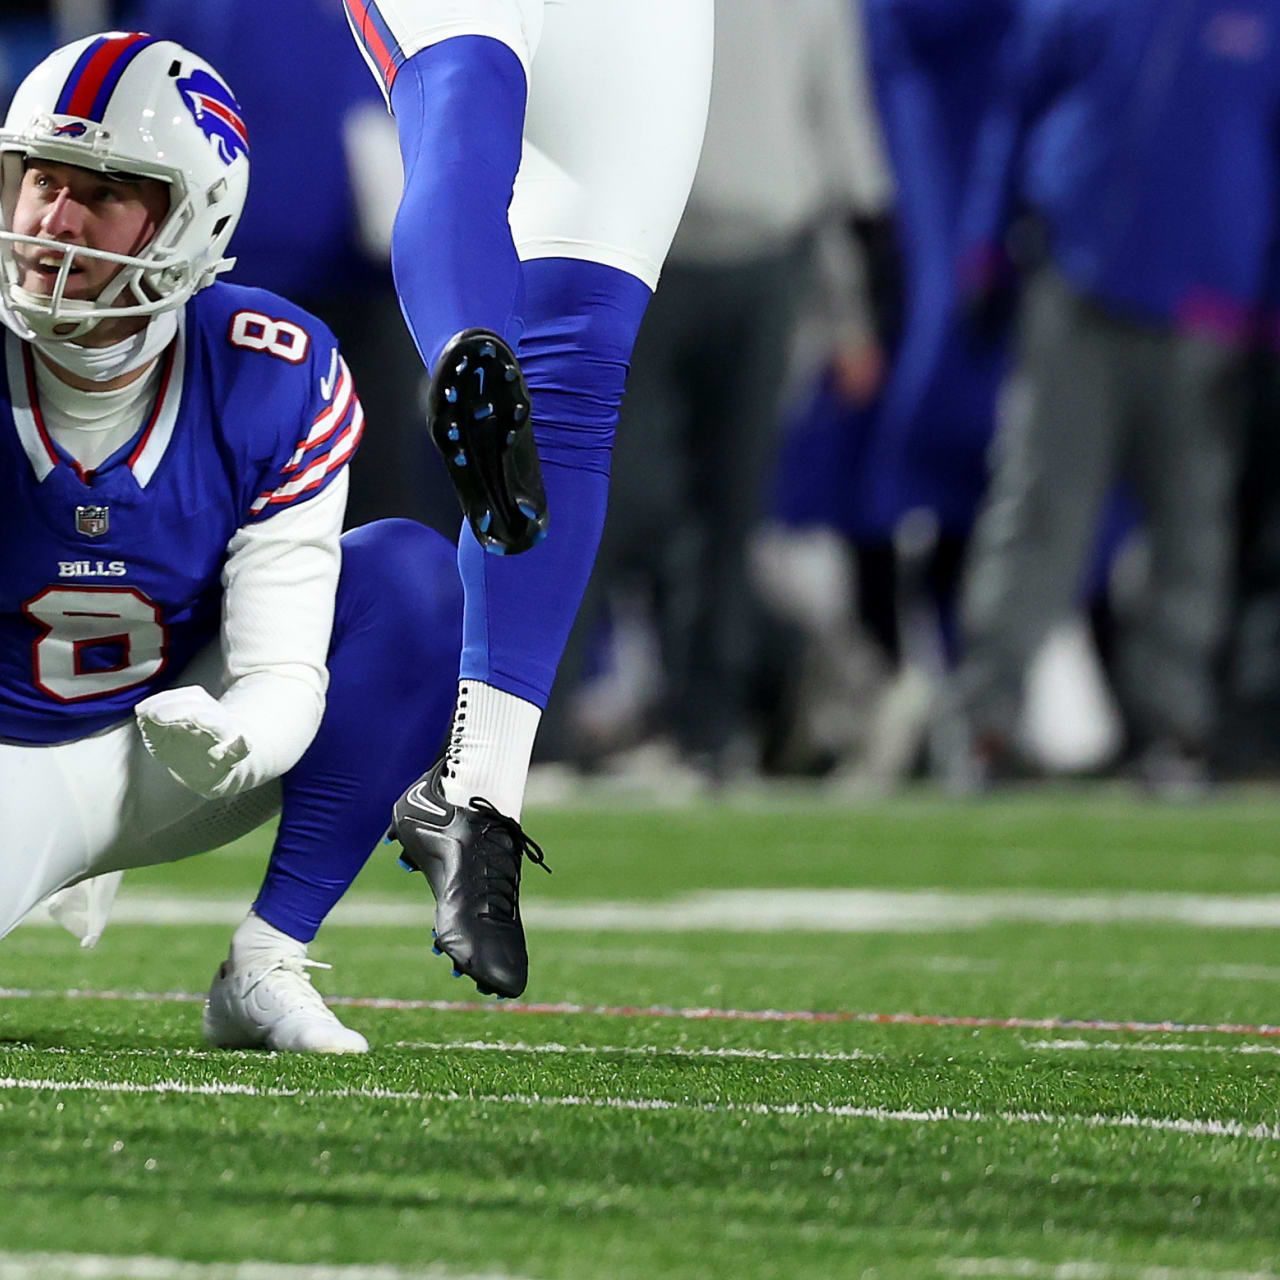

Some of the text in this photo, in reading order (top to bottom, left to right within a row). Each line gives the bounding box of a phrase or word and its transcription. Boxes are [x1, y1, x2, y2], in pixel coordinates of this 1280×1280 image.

[230, 311, 309, 363] 8
[58, 561, 127, 577] BILLS
[24, 585, 166, 702] 8
